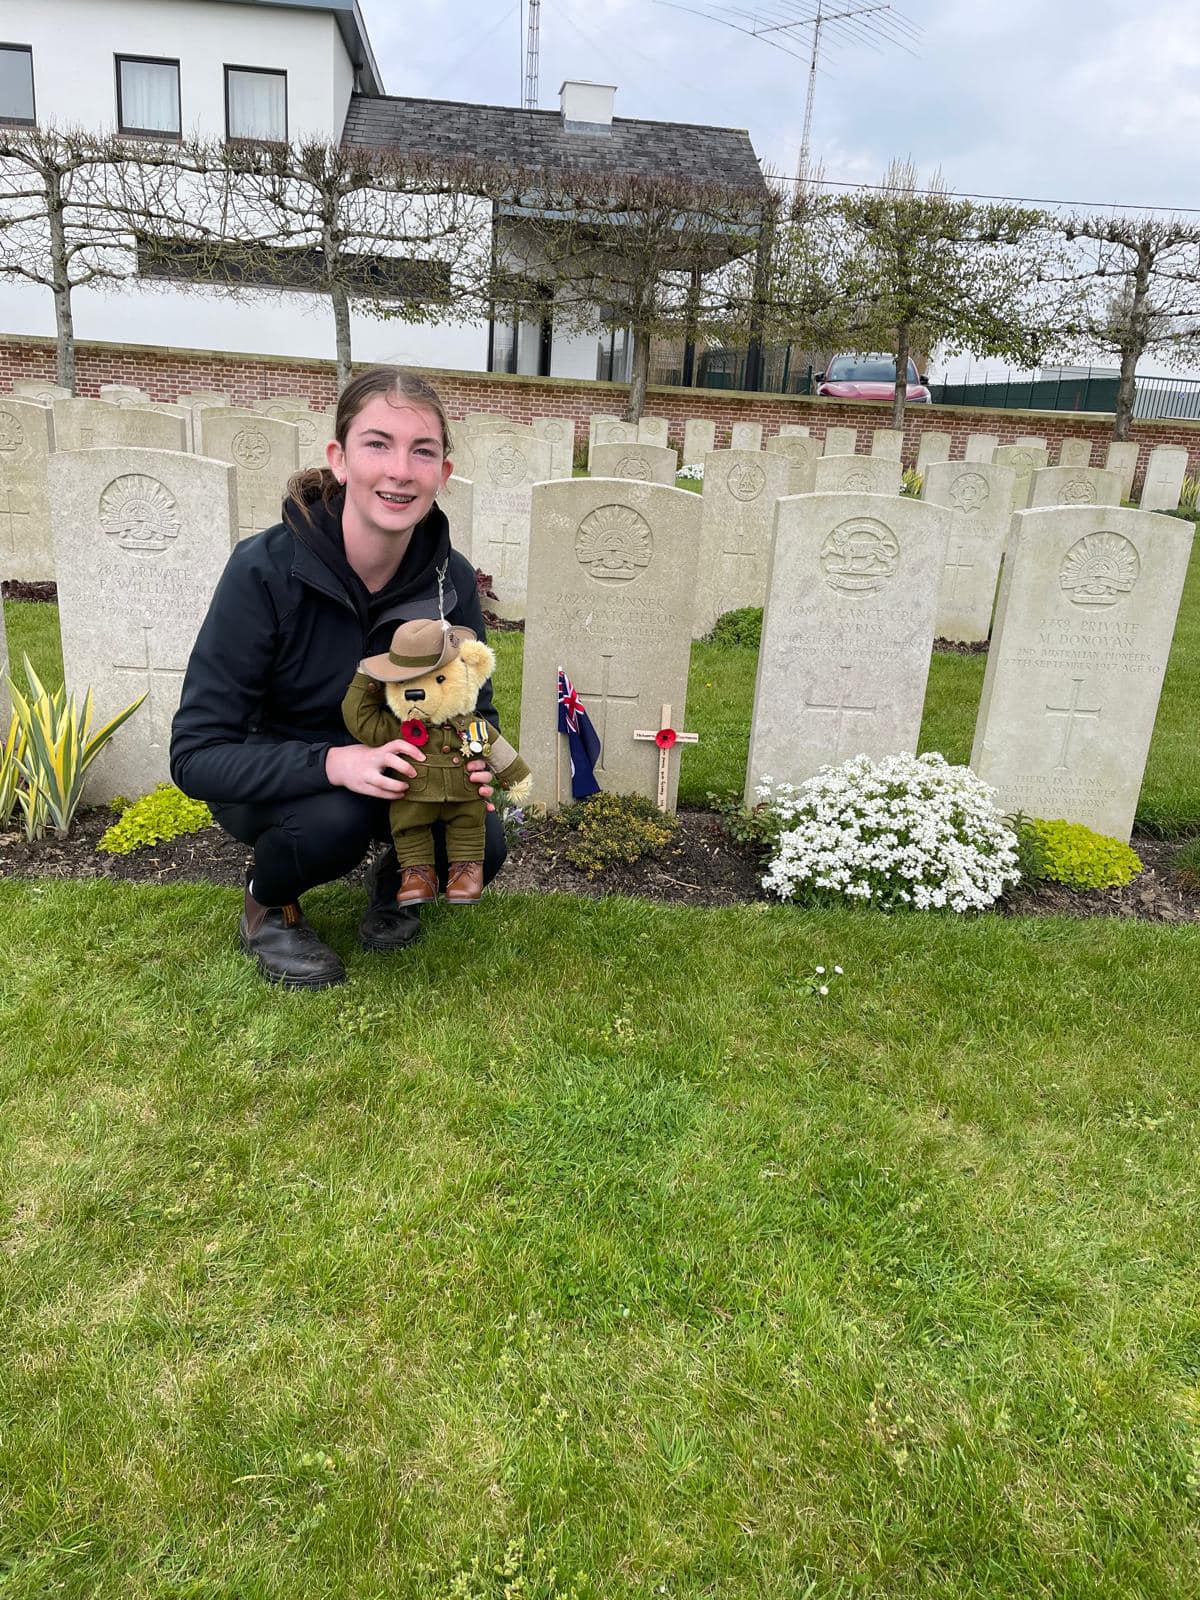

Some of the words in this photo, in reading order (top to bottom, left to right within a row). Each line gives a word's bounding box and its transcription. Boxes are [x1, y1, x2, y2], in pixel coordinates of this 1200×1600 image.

[131, 565, 192, 581] PRIVATE
[605, 596, 665, 610] GUNNER
[1080, 620, 1141, 635] PRIVATE
[1059, 633, 1137, 648] DONOVAN
[1040, 648, 1101, 660] AUSTRALIAN
[1105, 651, 1152, 662] PIONEERS
[1033, 659, 1092, 671] SEPTEMBER
[1015, 774, 1048, 784] THERE
[1078, 777, 1103, 787] LINK
[999, 784, 1034, 794] DEATH
[1038, 786, 1081, 796] CANNOT
[1084, 788, 1118, 798] SEVER
[1004, 795, 1031, 804] LOVE
[1038, 796, 1059, 806] AND
[1063, 798, 1109, 809] MEMORY
